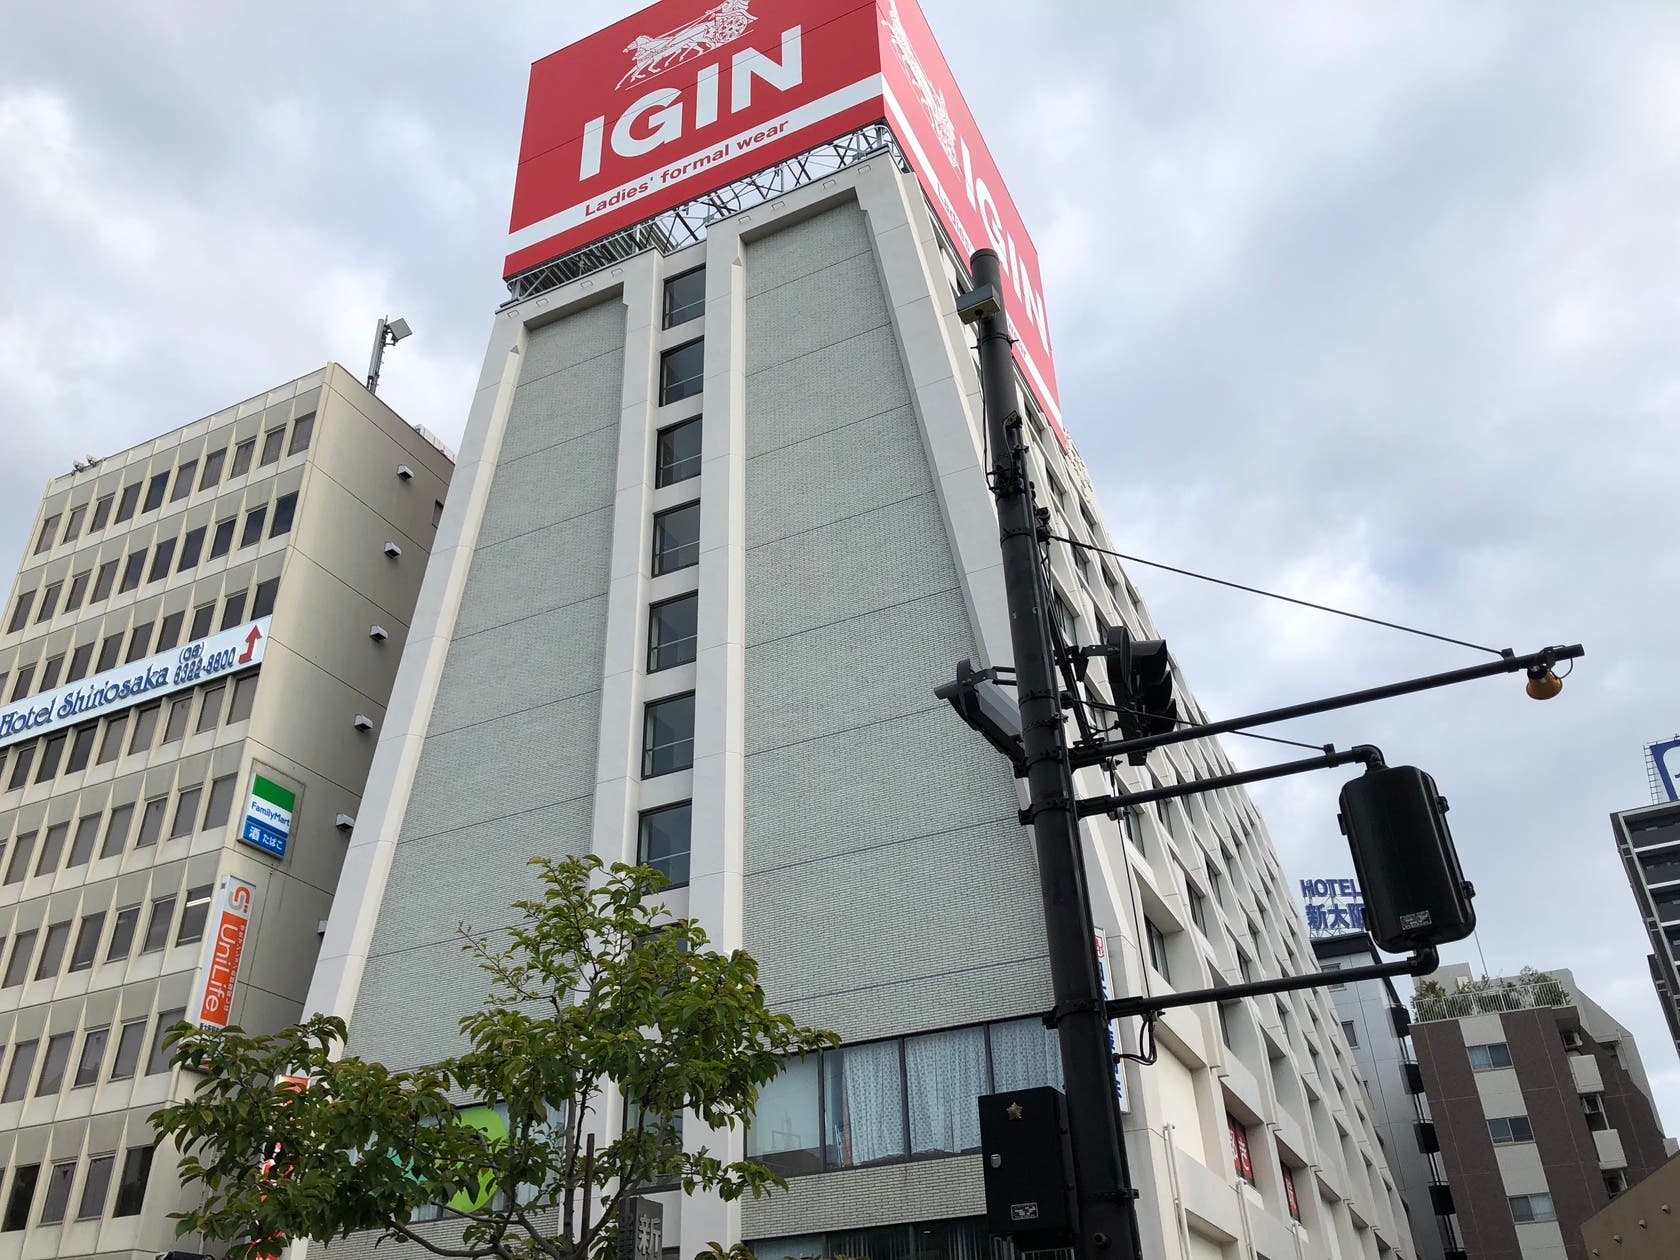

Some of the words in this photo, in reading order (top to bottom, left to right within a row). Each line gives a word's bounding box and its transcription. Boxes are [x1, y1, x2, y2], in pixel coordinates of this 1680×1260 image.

[579, 25, 803, 181] IGIN
[585, 176, 654, 217] Ladies'
[660, 144, 730, 184] formal
[736, 120, 789, 151] wear
[960, 136, 1052, 360] IGIN
[0, 699, 55, 737] Hotel
[249, 825, 260, 843] 酒
[262, 832, 284, 851] たばこ
[251, 801, 290, 828] FamilyMart
[1299, 878, 1362, 898] HOTEL
[203, 923, 238, 1013] UniLife
